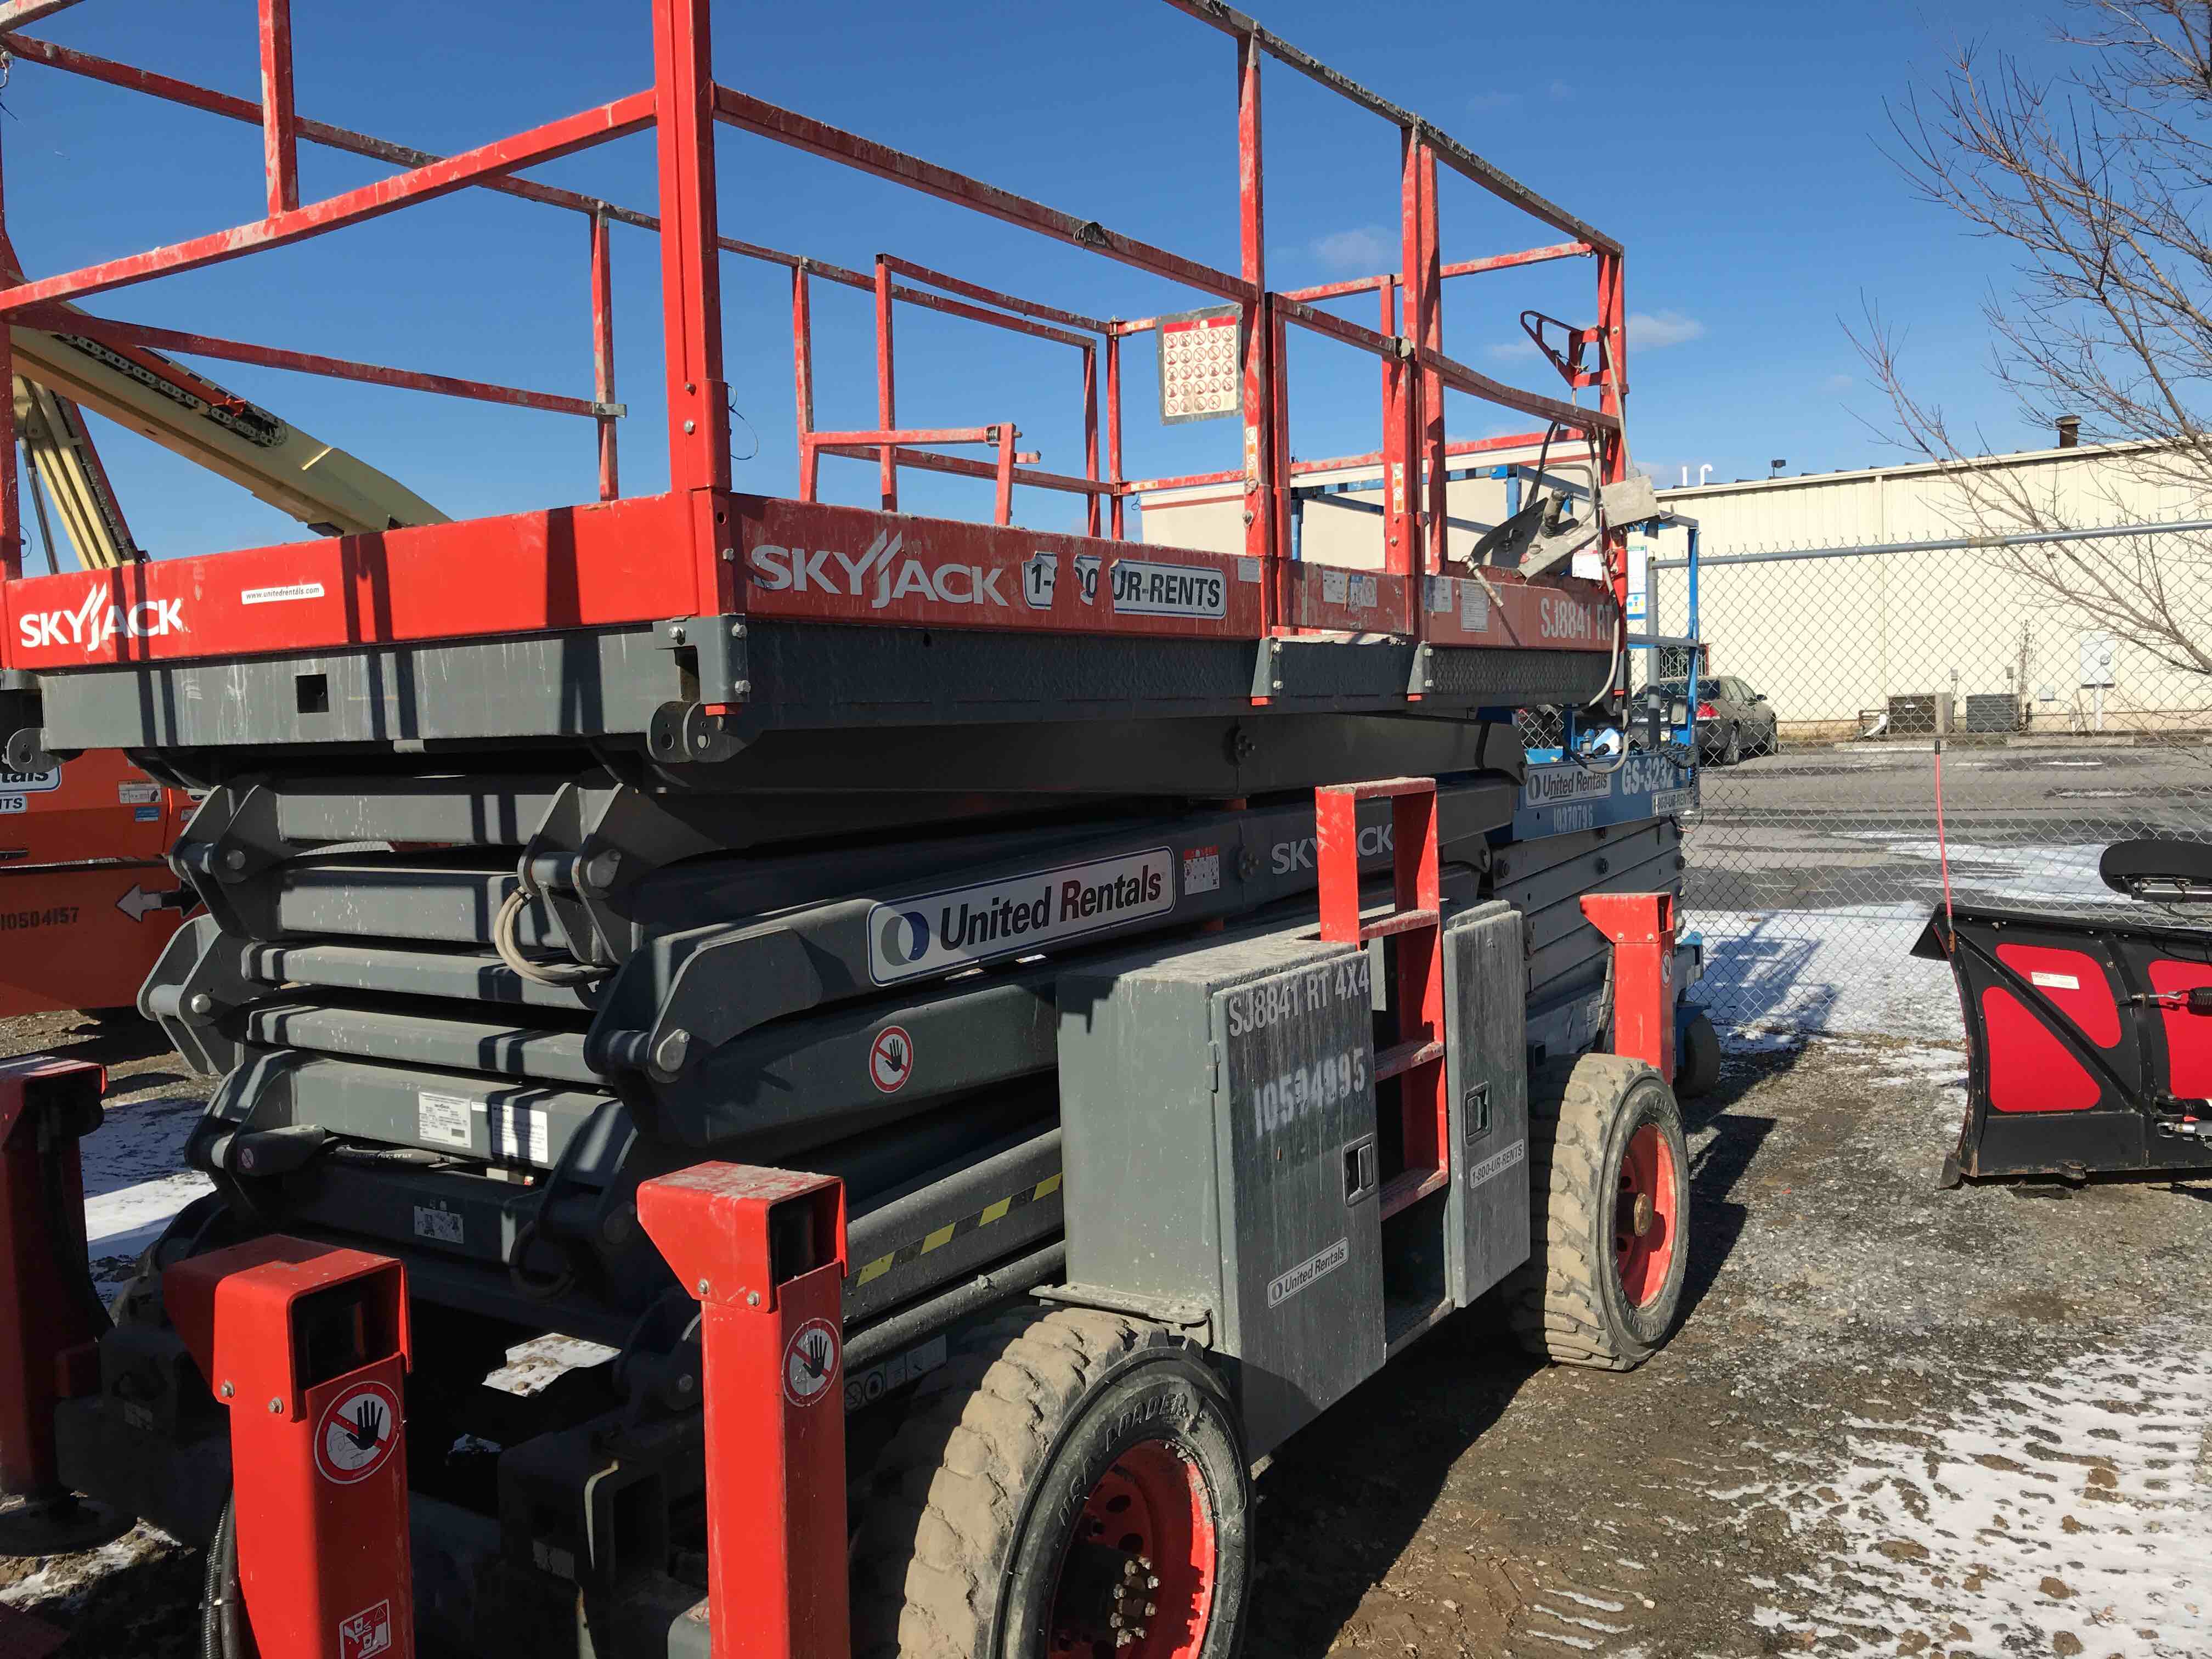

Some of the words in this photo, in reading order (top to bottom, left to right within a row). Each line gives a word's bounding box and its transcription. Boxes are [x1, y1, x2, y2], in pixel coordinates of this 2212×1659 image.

[751, 528, 1009, 608] SKYJACK
[19, 582, 190, 652] SKYJACK
[246, 587, 319, 600] www.unitedrentals.com
[1541, 597, 1591, 640] SJ8841
[1543, 774, 1573, 796] United
[1577, 772, 1607, 792] Rentals
[1271, 823, 1393, 874] SKCK
[940, 885, 1052, 951] United
[1060, 865, 1162, 922] Rentals
[1229, 978, 1301, 1036] SJ8841
[1306, 971, 1329, 1012] RT
[1335, 958, 1369, 1001] 4X4
[1472, 1144, 1522, 1184] 1-800-UR-RENTS
[1285, 1263, 1313, 1293] United
[1315, 1246, 1344, 1275] Rentals
